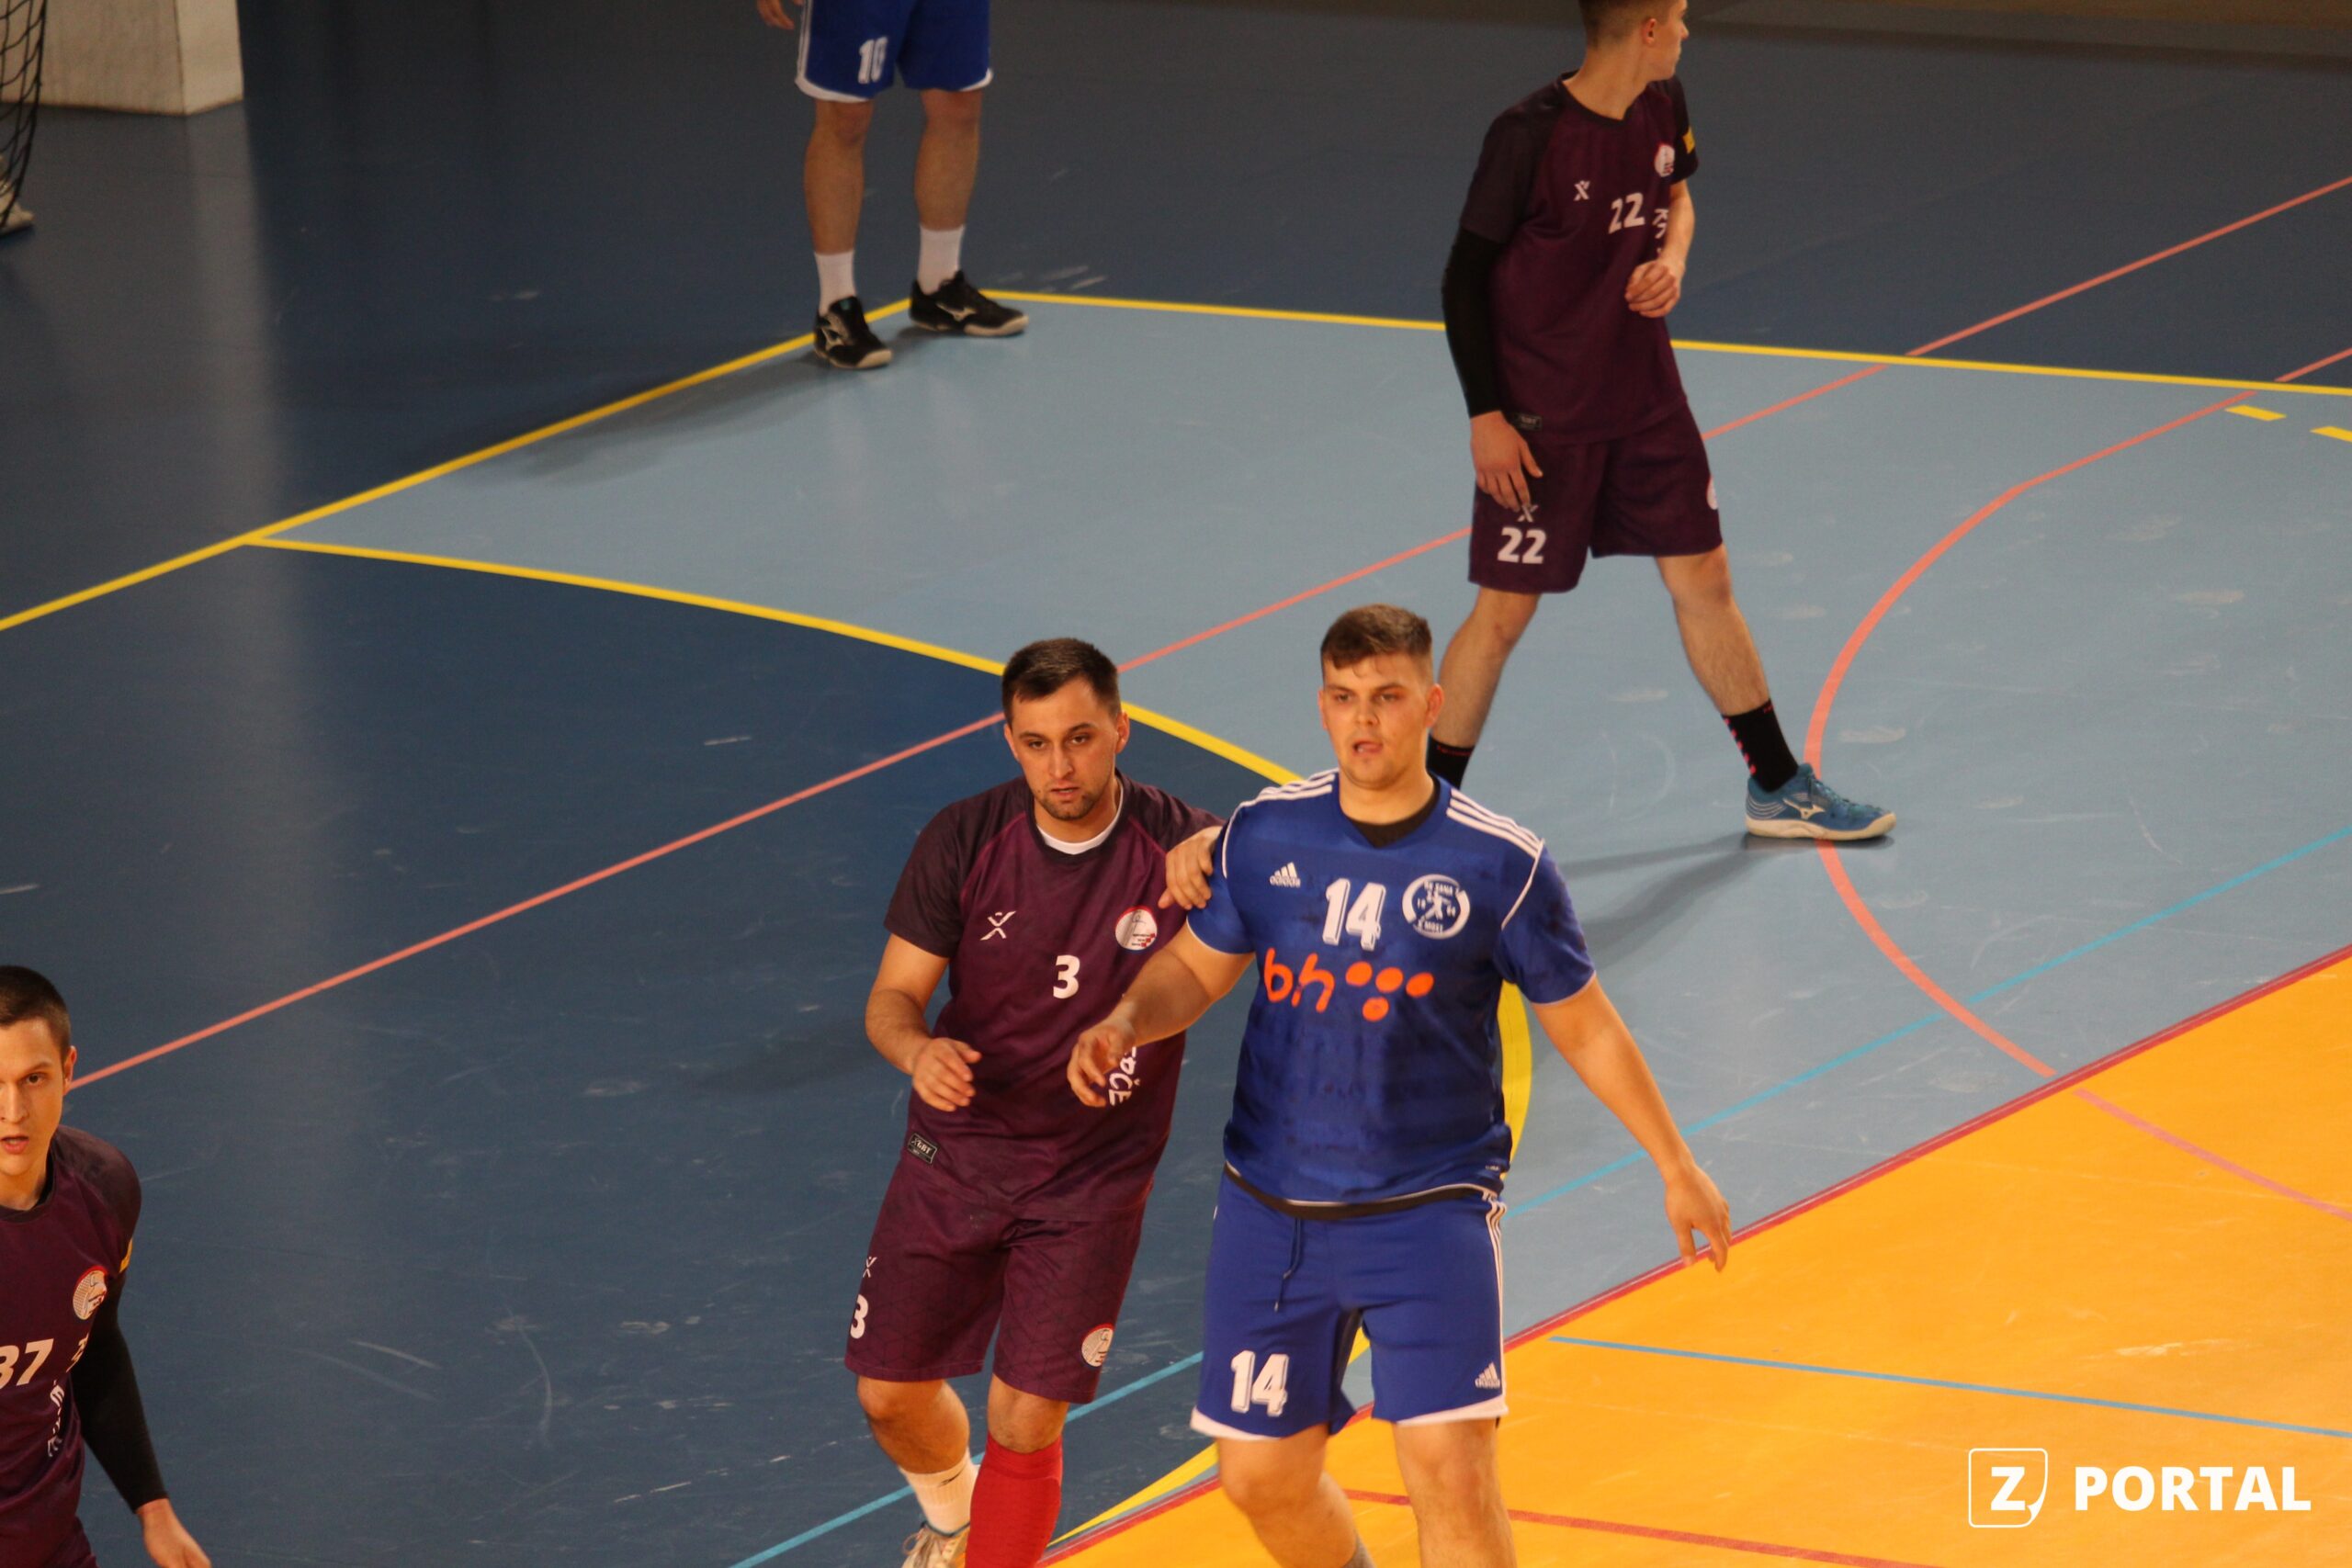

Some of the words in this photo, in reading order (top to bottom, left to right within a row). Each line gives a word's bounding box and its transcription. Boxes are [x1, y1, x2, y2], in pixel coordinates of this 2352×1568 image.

[1607, 191, 1646, 235] 22
[1497, 526, 1547, 565] 22
[1322, 877, 1387, 952] 14
[1052, 954, 1080, 999] 3
[850, 1293, 869, 1339] 3
[1229, 1349, 1290, 1418] 14
